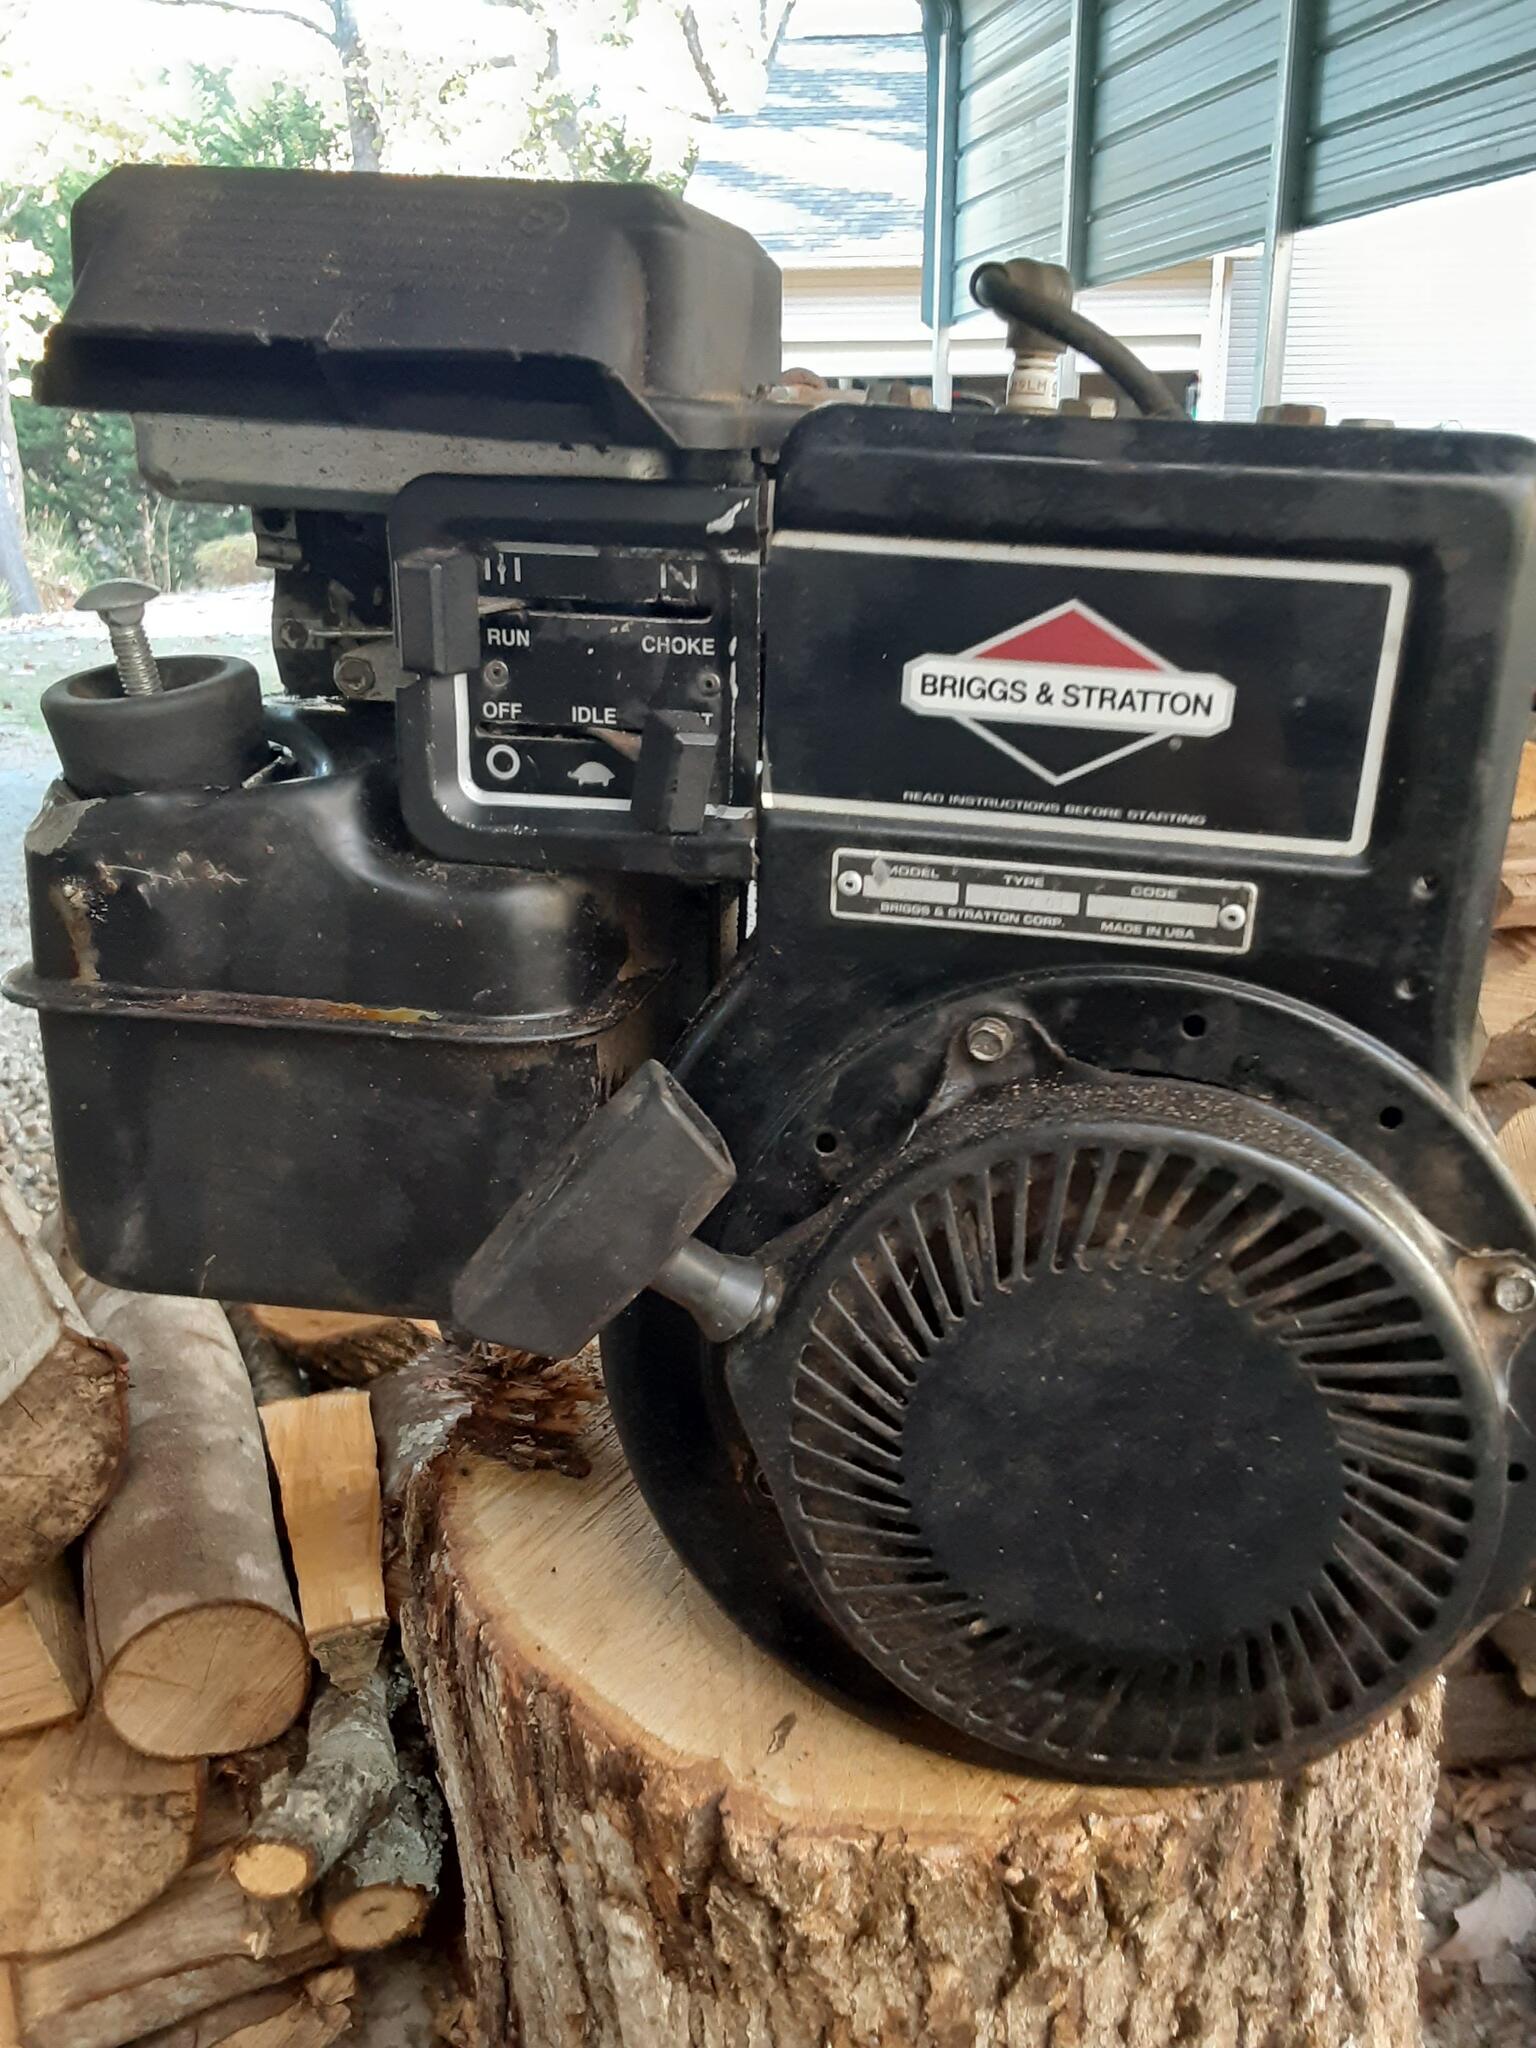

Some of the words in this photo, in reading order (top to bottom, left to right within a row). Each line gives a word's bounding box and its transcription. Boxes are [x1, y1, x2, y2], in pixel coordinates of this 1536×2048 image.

[487, 628, 530, 647] RUN
[641, 635, 715, 656] CHOKE
[920, 673, 1027, 704] BRIGGS
[1036, 681, 1054, 705] &
[1062, 684, 1213, 717] STRATTON
[482, 702, 522, 719] OFF
[571, 706, 617, 725] IDLE
[903, 790, 944, 804] READ
[949, 793, 1061, 813] INSTRUCTIONS
[1064, 804, 1123, 821] BEFORE
[1127, 809, 1207, 826] STARTING
[1003, 874, 1045, 889] TYPE
[1130, 886, 1178, 900] CODE
[880, 902, 930, 917] BRIGGS
[947, 906, 1021, 926] STRATTON
[1023, 913, 1066, 928] CORP.
[1100, 921, 1142, 937] MADE
[1146, 926, 1161, 938] IN
[1164, 926, 1195, 940] USA
